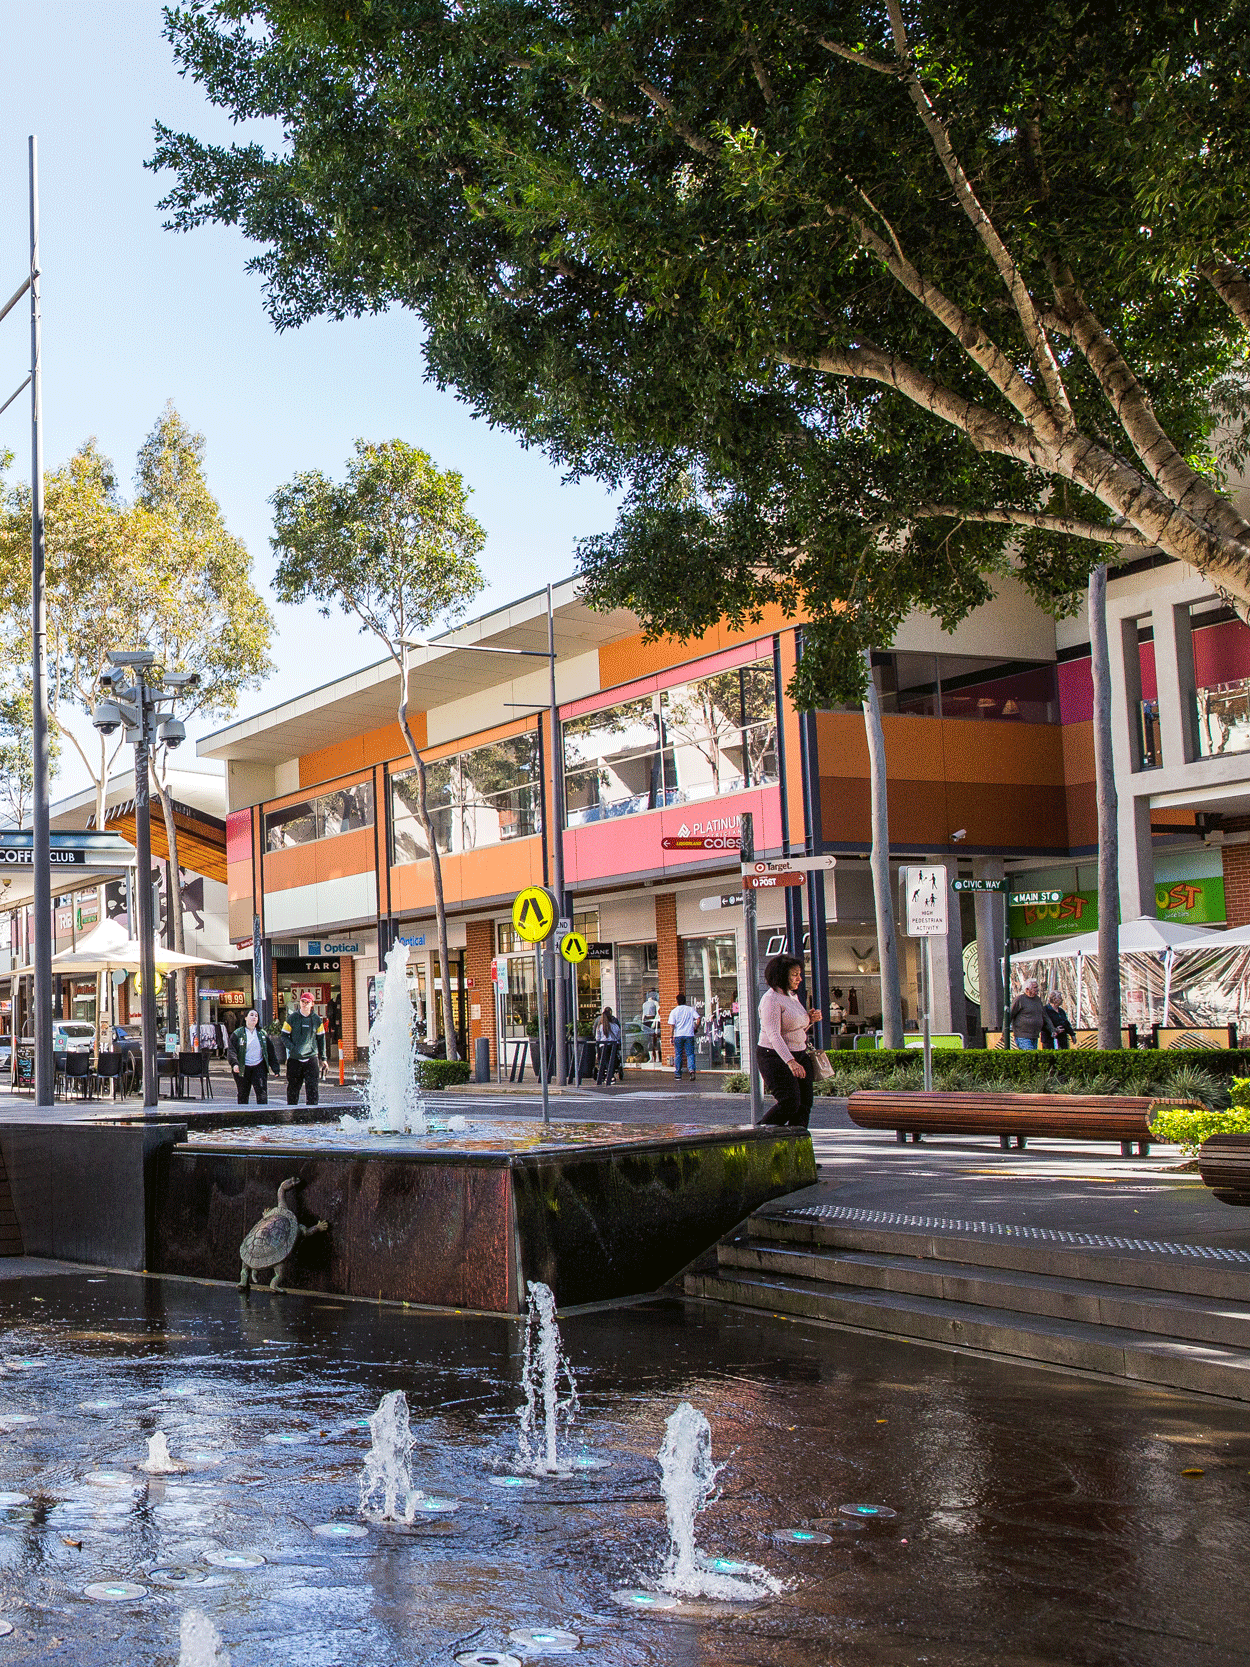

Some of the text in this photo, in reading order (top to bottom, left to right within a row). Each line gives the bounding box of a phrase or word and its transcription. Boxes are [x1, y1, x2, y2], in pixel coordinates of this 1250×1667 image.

[704, 837, 743, 849] coles
[49, 852, 75, 862] CLUB
[759, 877, 777, 887] POST
[962, 880, 1001, 889] CIVIC WAY
[1019, 892, 1051, 902] MAIN ST
[323, 942, 359, 954] Optical
[305, 962, 340, 970] TARO
[291, 988, 321, 1000] SAE
